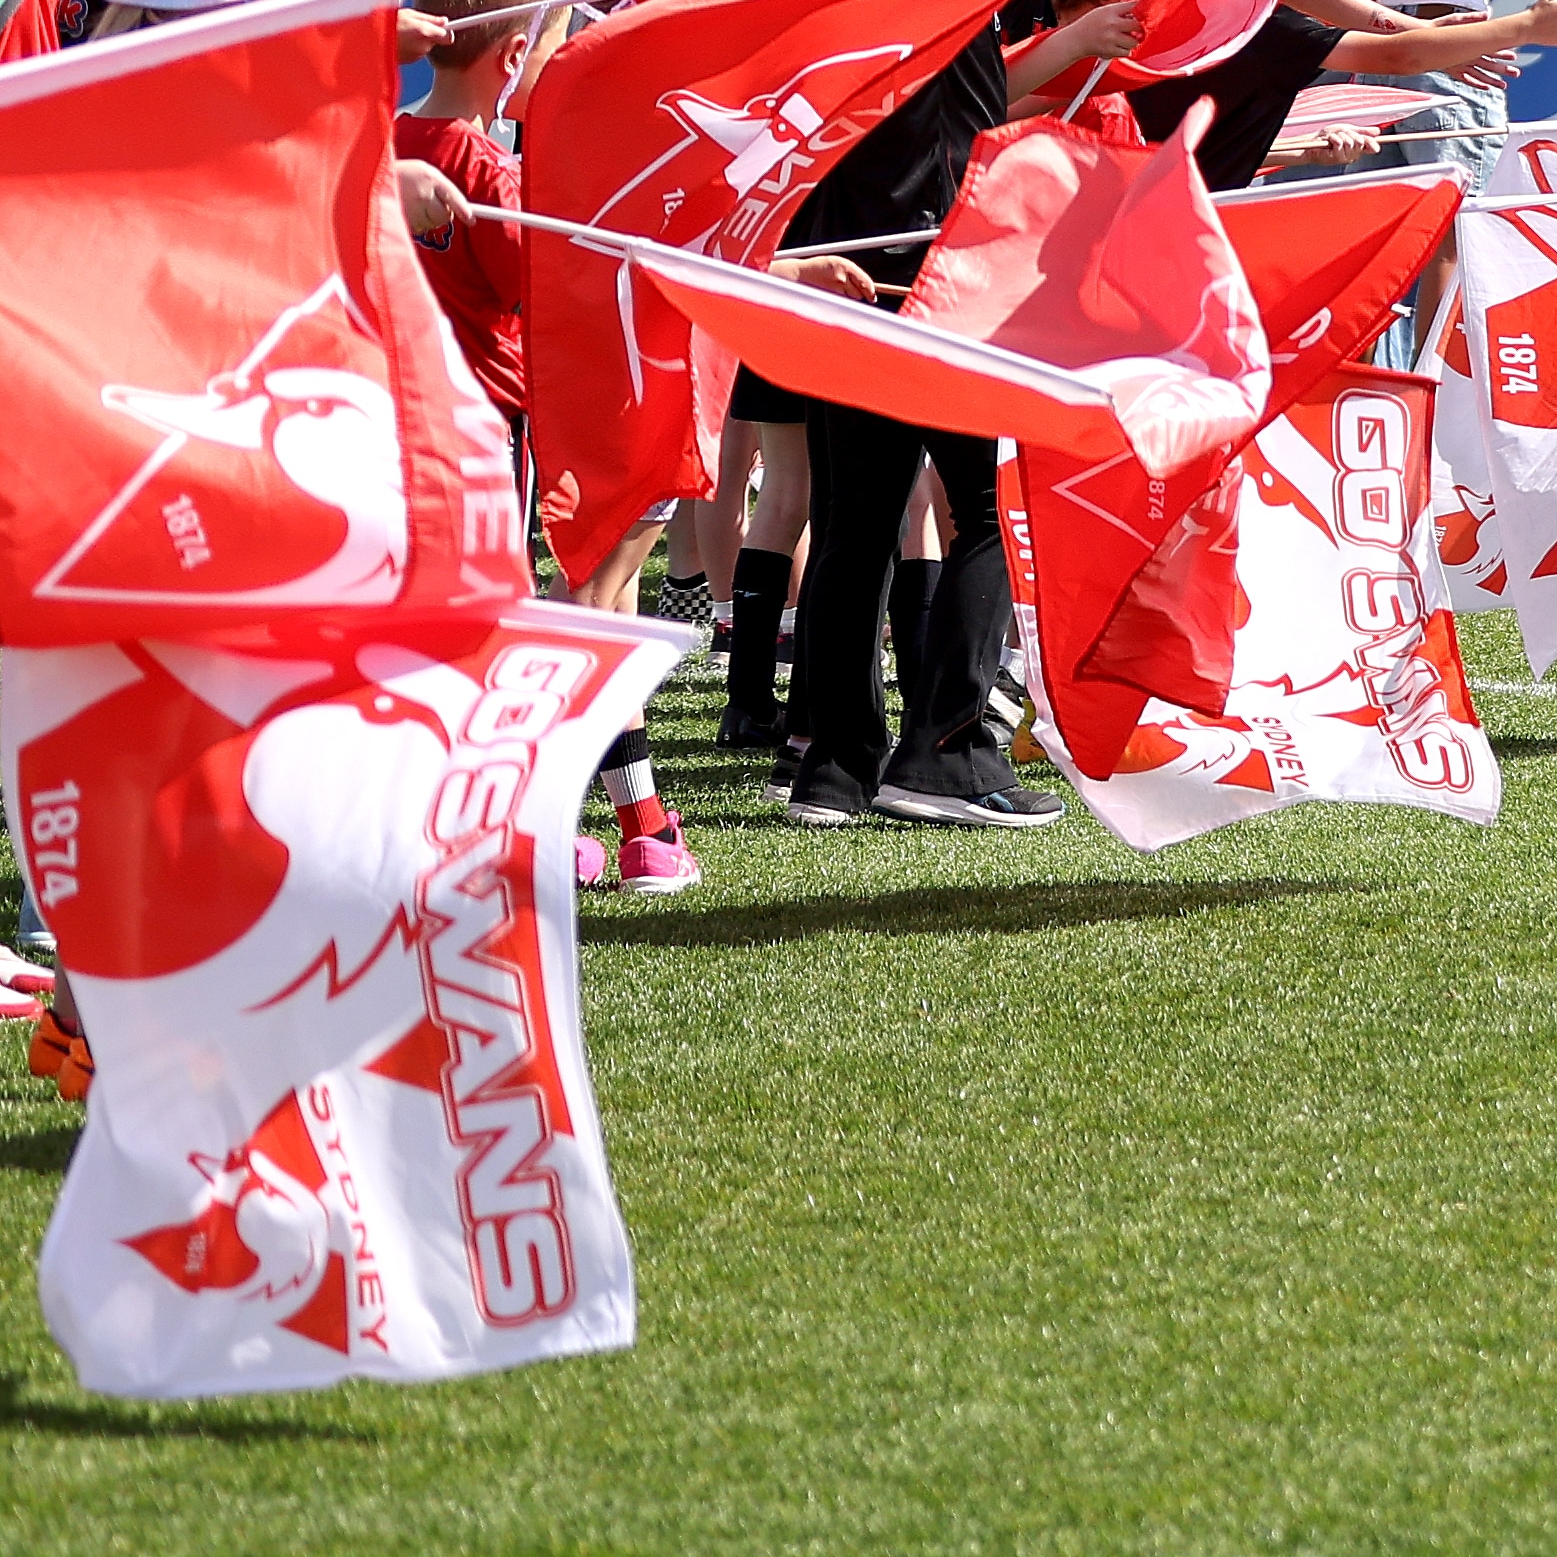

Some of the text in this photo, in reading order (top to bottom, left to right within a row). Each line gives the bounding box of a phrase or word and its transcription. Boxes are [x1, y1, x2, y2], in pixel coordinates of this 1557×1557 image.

[1497, 332, 1539, 395] 1874
[1148, 479, 1165, 520] 874
[1332, 388, 1410, 552] GO
[161, 493, 212, 571] 1874
[1251, 715, 1311, 788] SYDNEY
[30, 779, 81, 911] 1874
[415, 644, 600, 1330] GO SWANS
[308, 1082, 389, 1355] SYDNEY
